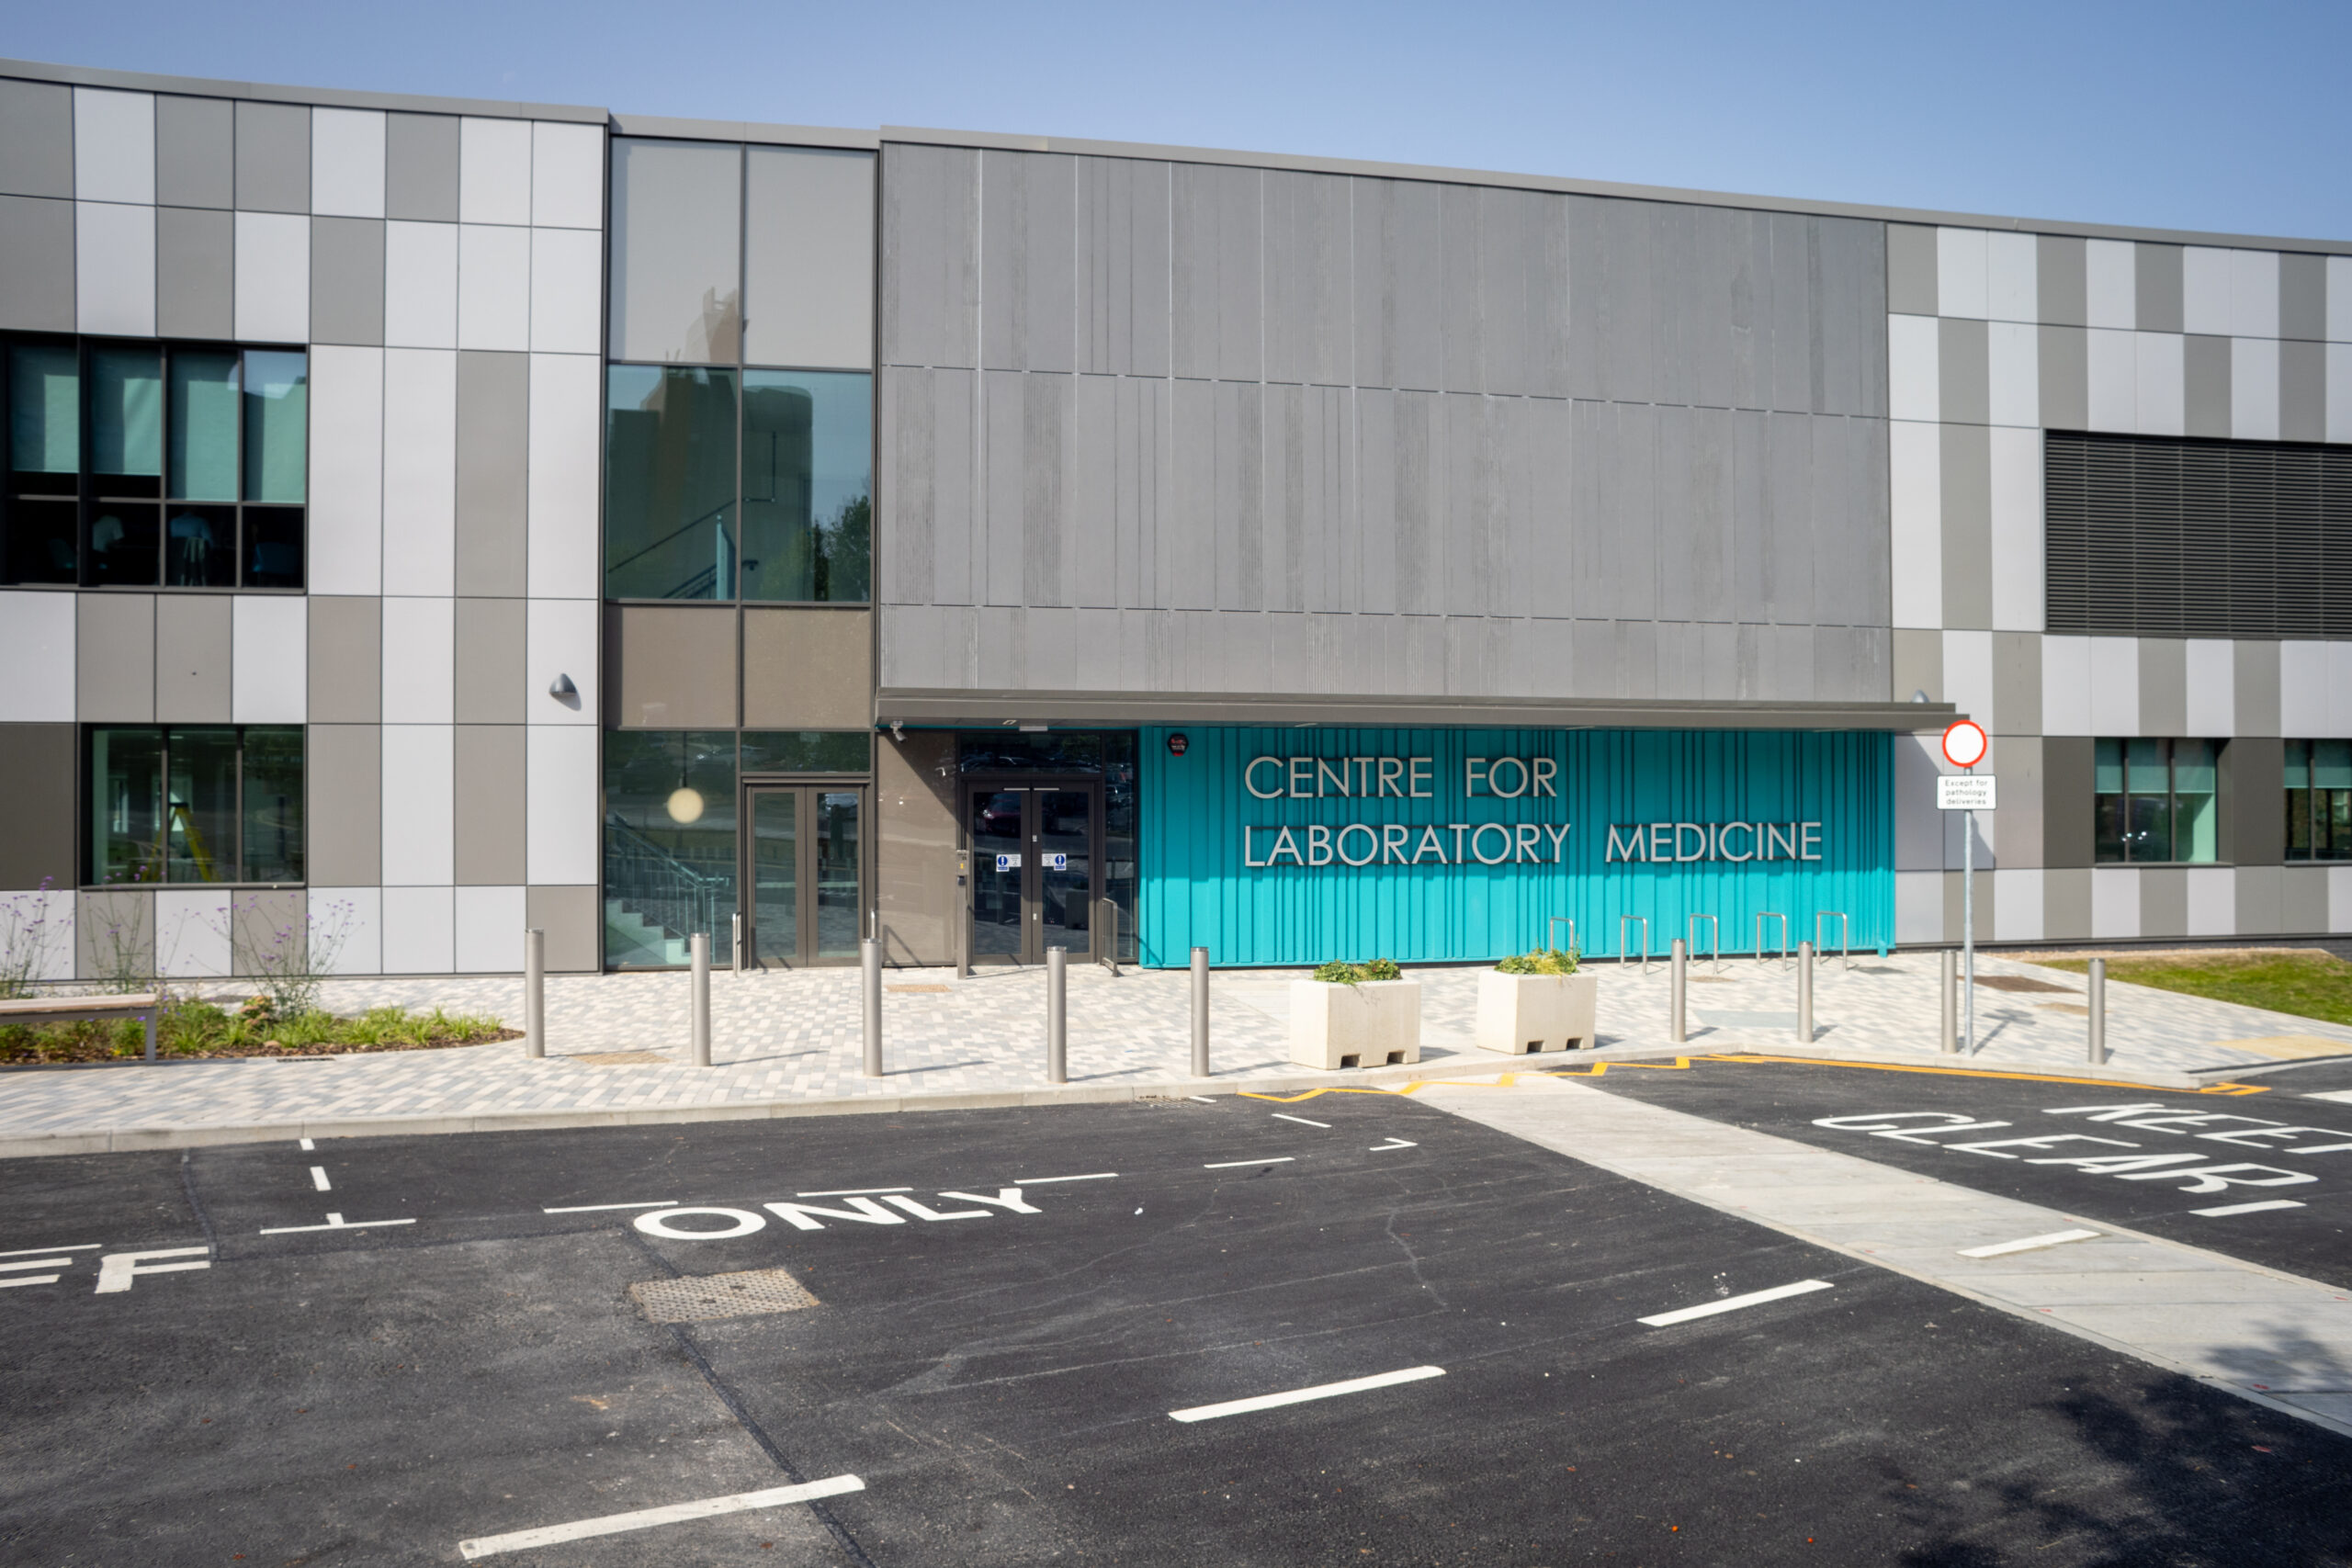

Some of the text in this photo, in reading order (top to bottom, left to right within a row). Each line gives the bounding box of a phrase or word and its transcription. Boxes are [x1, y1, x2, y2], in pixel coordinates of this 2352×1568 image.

[1244, 755, 1558, 799] CENTRE FOR
[1944, 779, 1973, 787] Except
[1945, 789, 1986, 797] pathology
[1244, 820, 1823, 867] LABORATORY MEDICINE
[1812, 1111, 2320, 1194] CLEAR
[633, 1188, 1043, 1240] ONLY
